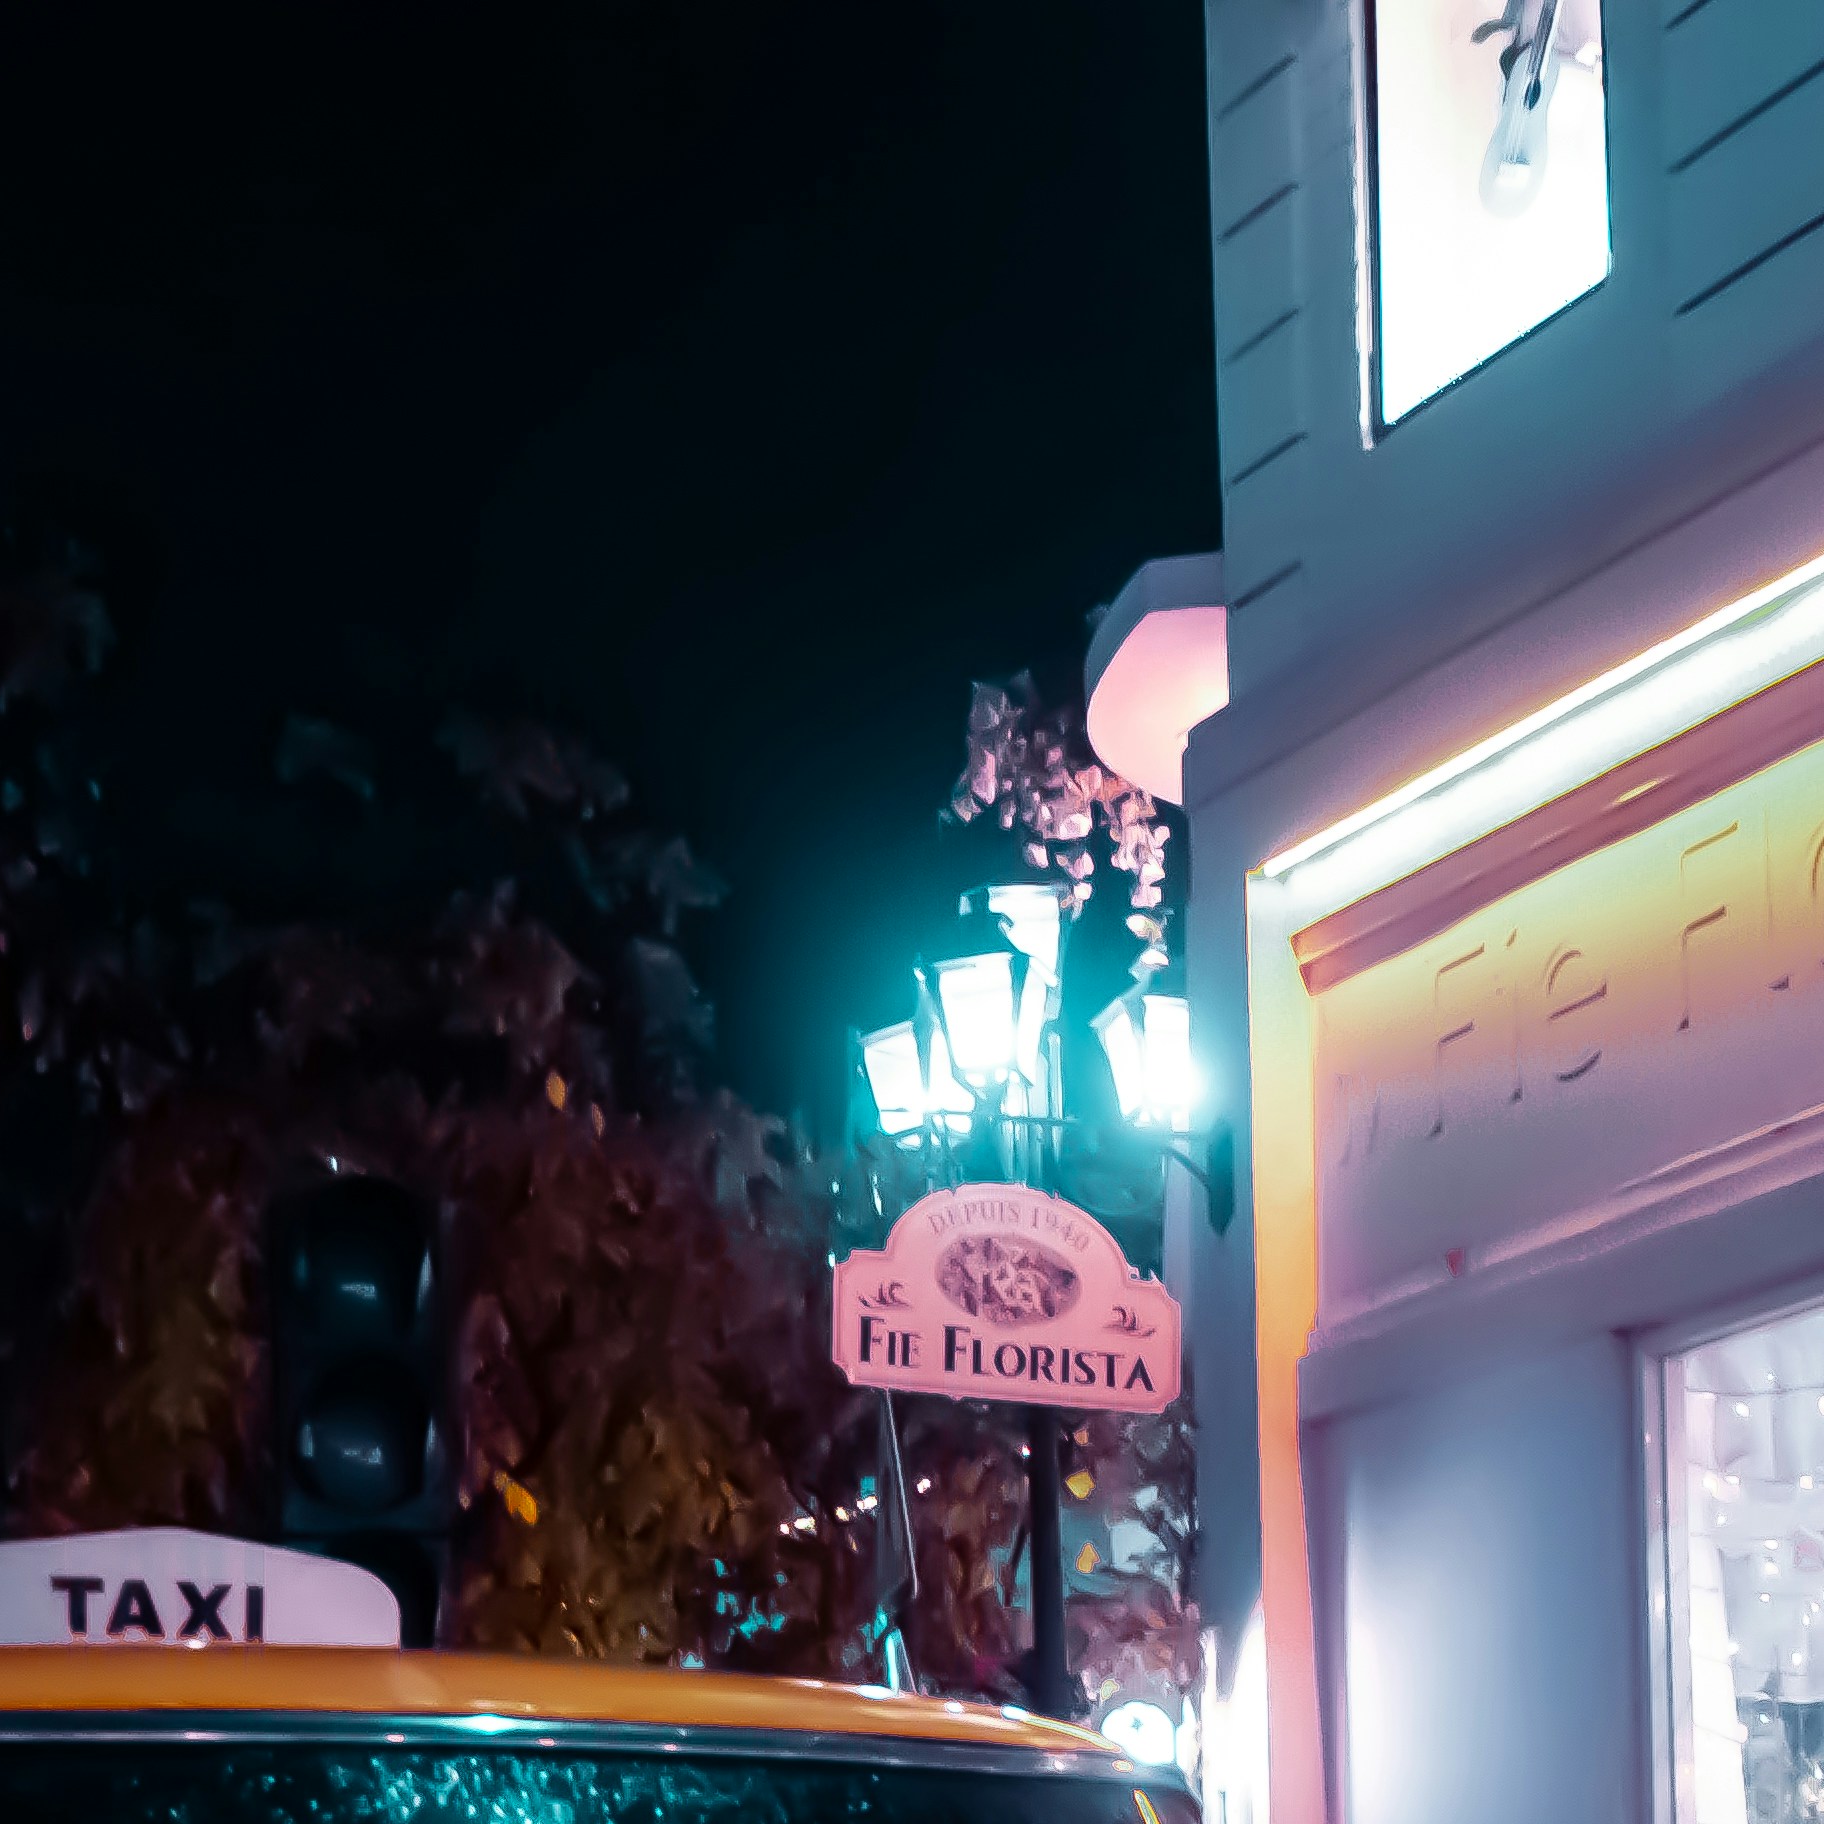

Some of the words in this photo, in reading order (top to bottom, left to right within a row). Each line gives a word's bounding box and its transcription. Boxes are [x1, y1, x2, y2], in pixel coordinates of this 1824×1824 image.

[1422, 912, 1608, 1142] Fie
[926, 1199, 1022, 1235] DEPUIS
[857, 1315, 922, 1370] FIE
[941, 1324, 1155, 1393] FLORISTA
[50, 1574, 264, 1643] TAXI
